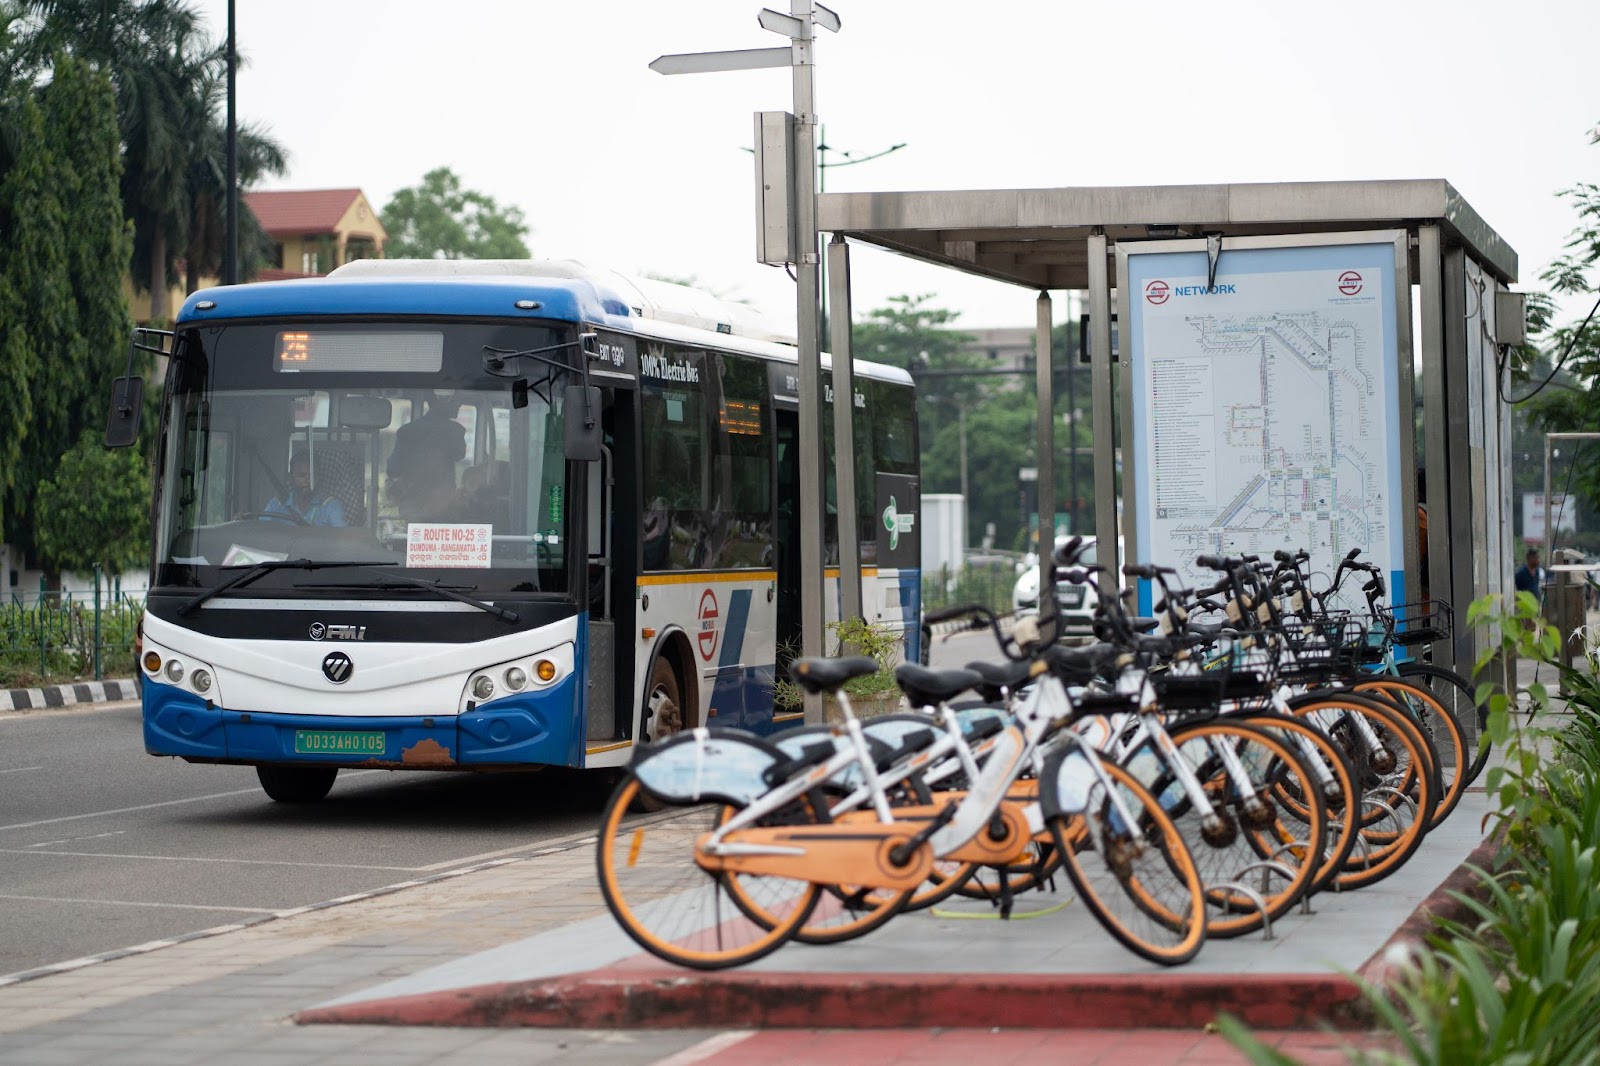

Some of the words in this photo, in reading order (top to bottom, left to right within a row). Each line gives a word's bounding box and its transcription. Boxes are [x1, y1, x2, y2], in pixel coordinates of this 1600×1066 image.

[1175, 284, 1236, 296] NETWORK
[600, 344, 610, 361] EXIT
[641, 353, 660, 379] 100%
[660, 356, 686, 382] Electric
[685, 360, 699, 383] Bus
[424, 528, 450, 541] ROUTE
[452, 529, 475, 541] NO-25
[410, 543, 437, 552] DUMDUMA
[441, 544, 476, 552] RANGAMATIA
[480, 544, 488, 552] AC
[306, 735, 383, 750] OD33AH0105
